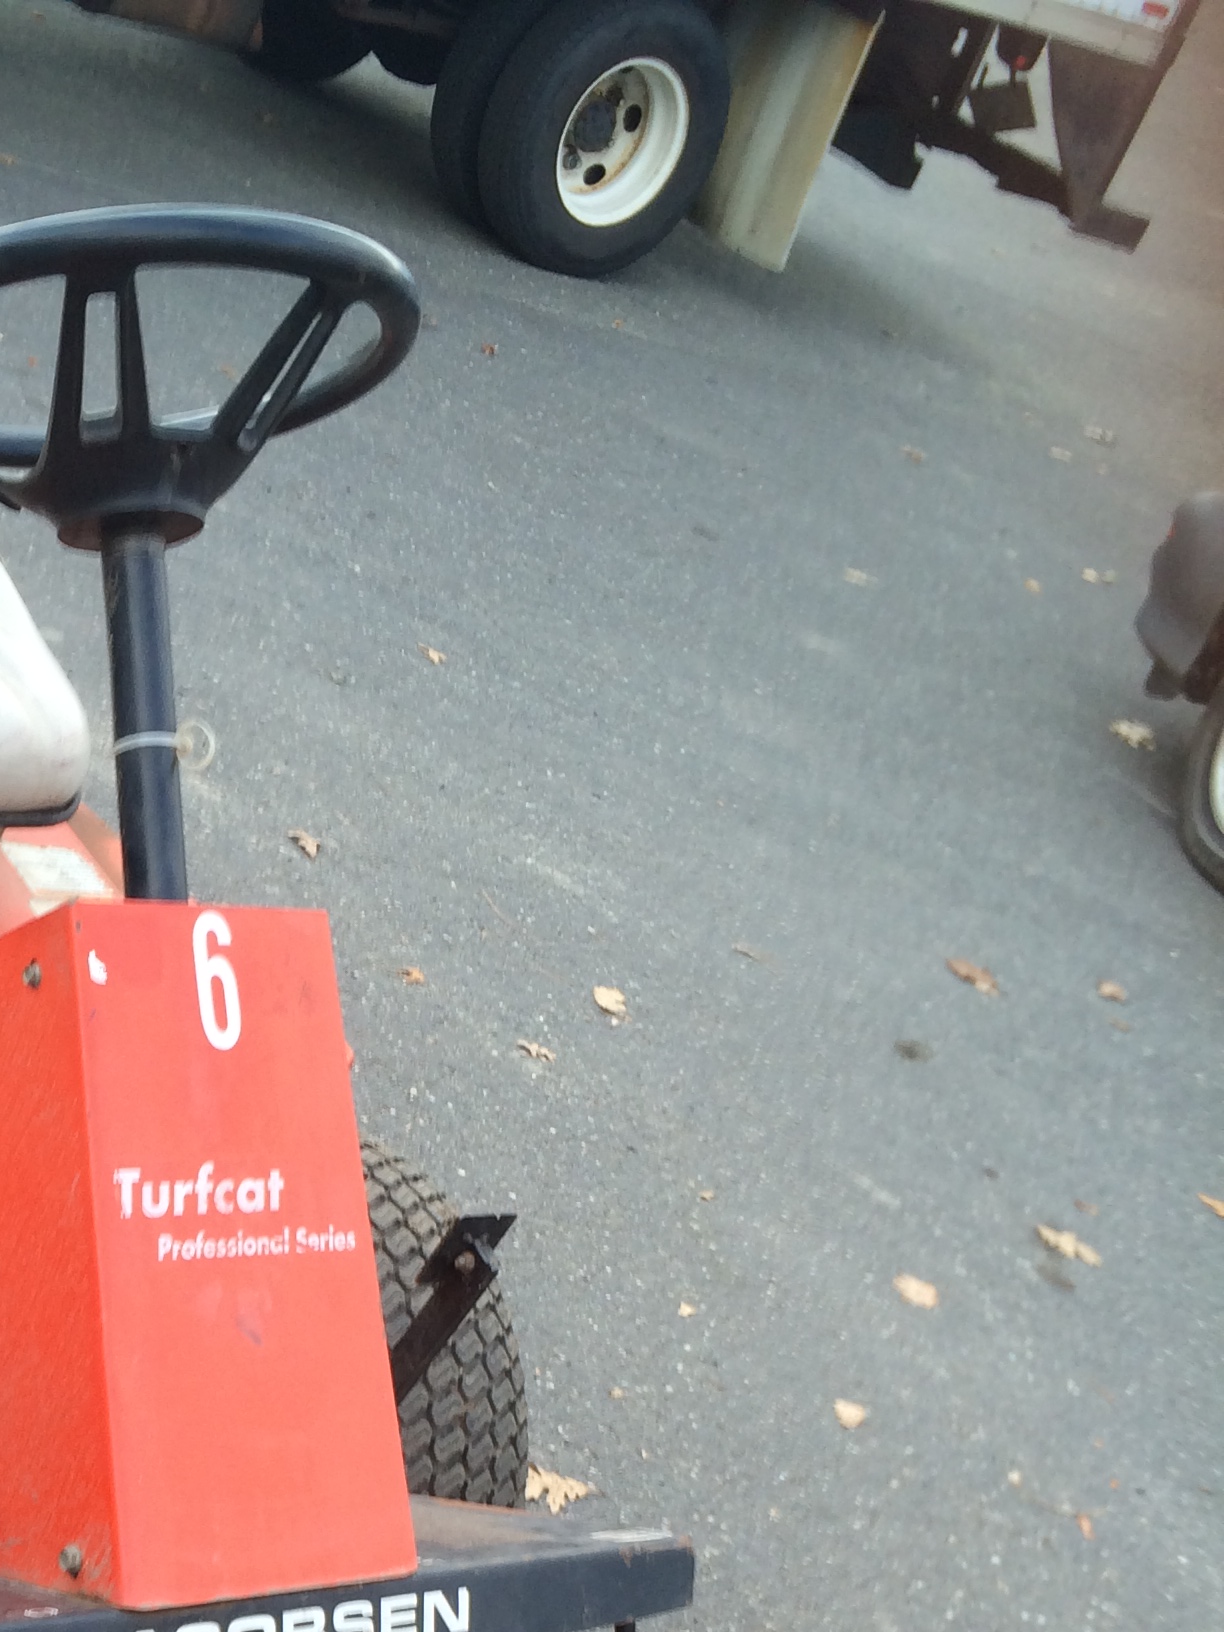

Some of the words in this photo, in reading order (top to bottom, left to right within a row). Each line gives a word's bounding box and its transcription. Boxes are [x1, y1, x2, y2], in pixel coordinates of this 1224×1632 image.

[192, 910, 242, 1051] 6
[114, 1161, 284, 1219] Turfcat
[158, 1225, 290, 1261] Professional
[296, 1224, 356, 1254] Series
